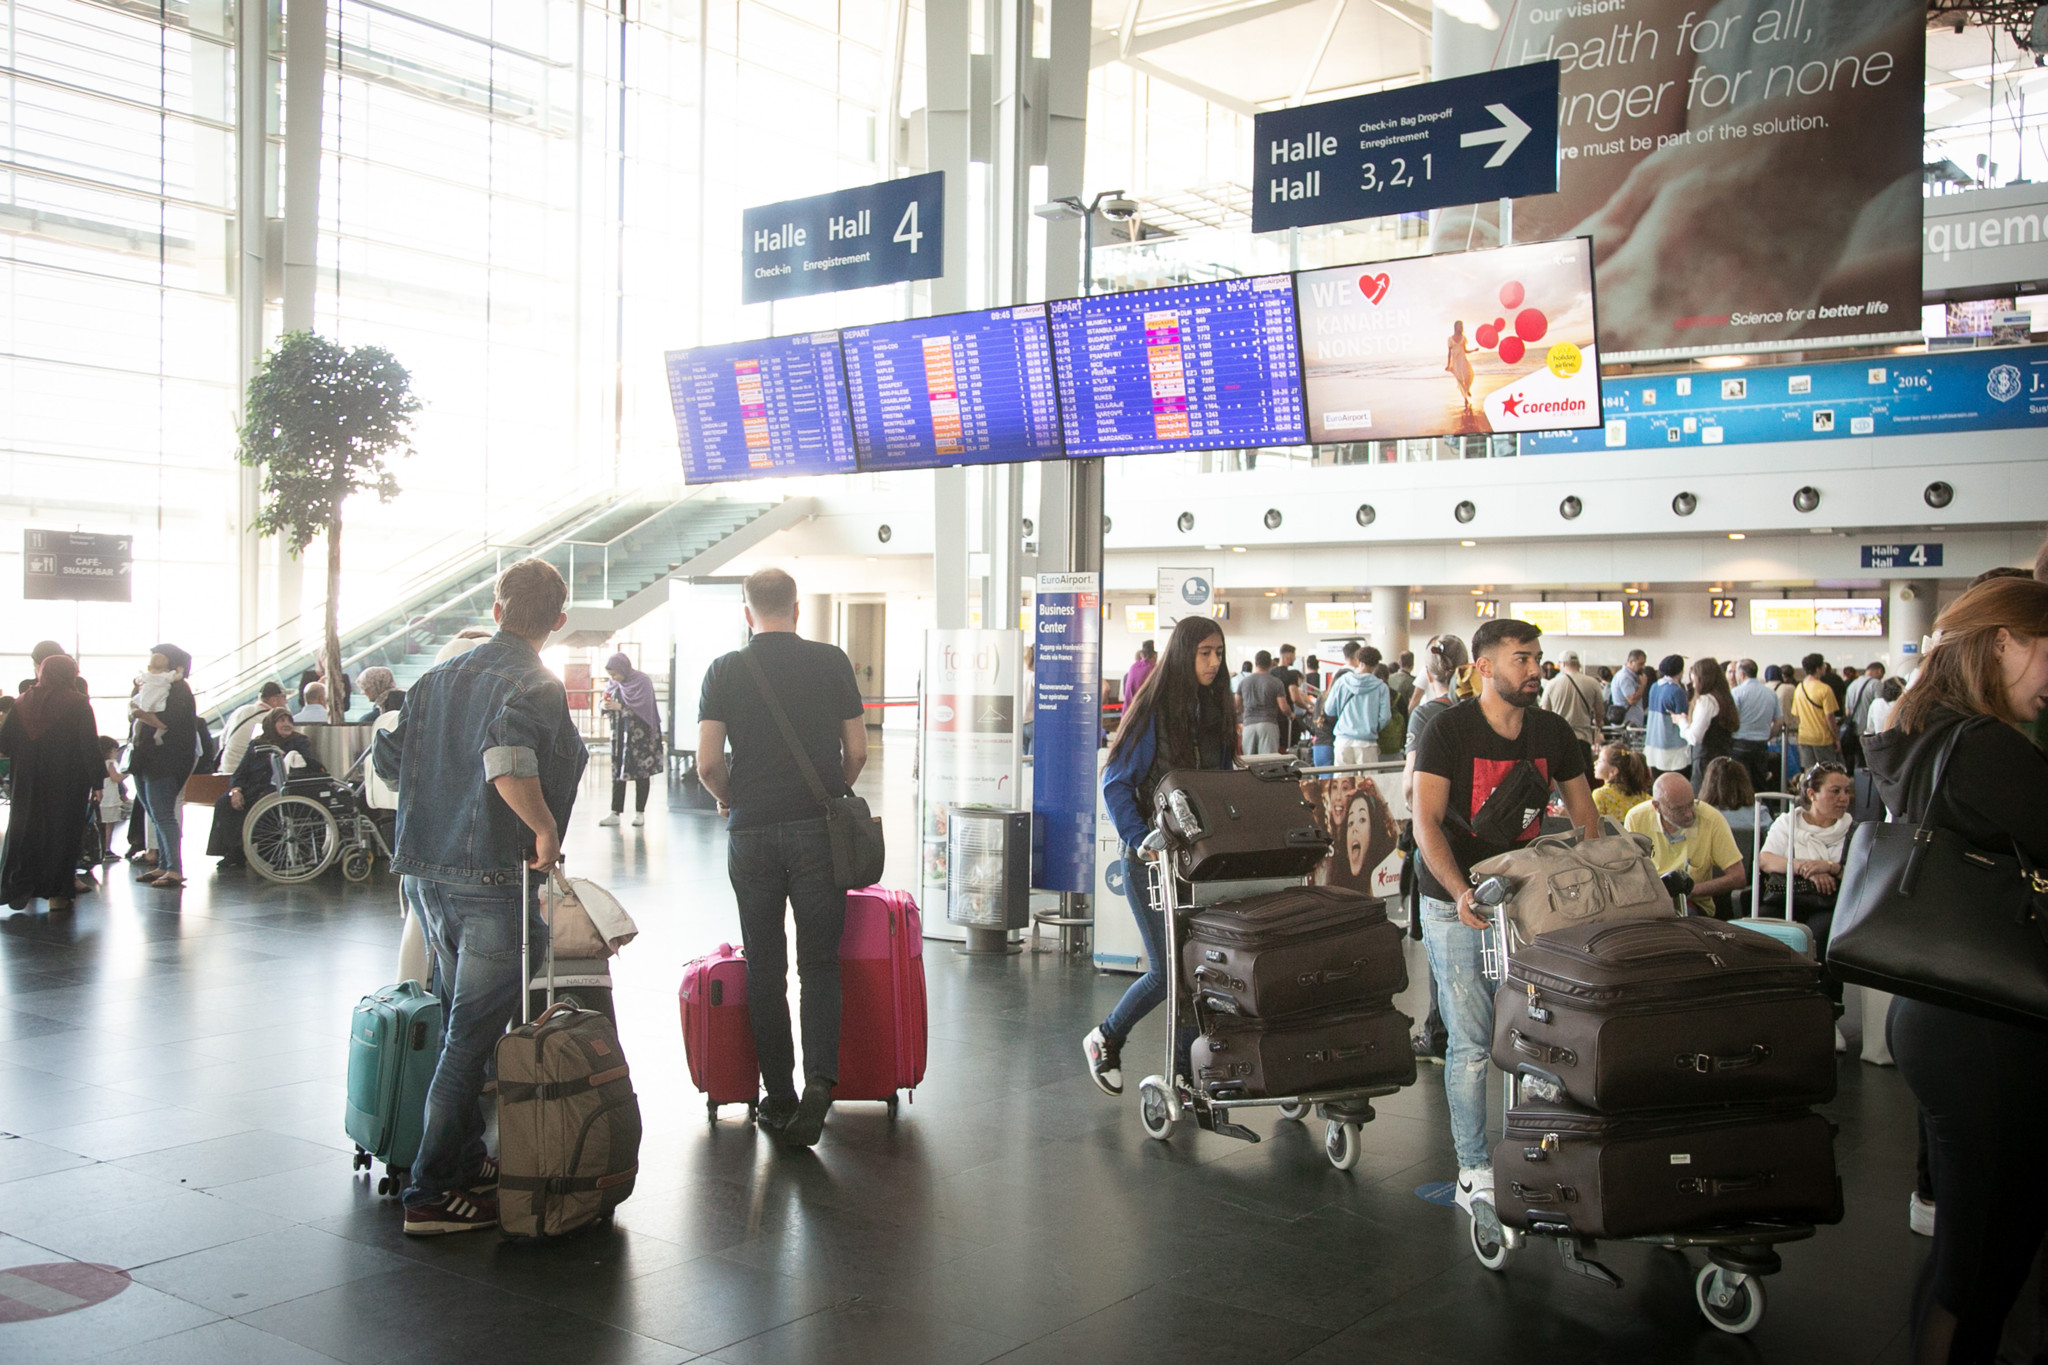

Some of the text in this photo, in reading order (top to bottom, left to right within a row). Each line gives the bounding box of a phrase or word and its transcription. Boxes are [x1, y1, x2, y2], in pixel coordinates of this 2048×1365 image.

[1530, 0, 1626, 24] Our vision:
[1520, 0, 1813, 74] Health for all,
[1687, 65, 1752, 110] for
[1764, 51, 1893, 100] none
[1359, 108, 1453, 133] Check-in Bag Drop-off
[1360, 130, 1430, 150] Enregistrement
[1561, 114, 1829, 161] re must be part of the solution.
[1271, 131, 1338, 165] Halle
[1271, 170, 1320, 203] Hall
[754, 201, 923, 254] Halle Hall 4
[1923, 213, 2048, 262] quem
[754, 251, 871, 279] Check-in Enregistrement
[1226, 281, 1250, 292] 09:45
[1311, 280, 1352, 308] WE
[990, 310, 1010, 321] 09:45
[1316, 308, 1411, 336] KANAREN
[1730, 301, 1889, 327] Science for a better life
[1086, 324, 1127, 334] ISTANBUL-SAW
[1087, 334, 1116, 342] BUDAPEST
[1317, 331, 1414, 359] NONSTOP
[1899, 376, 1927, 388] 2016
[1523, 397, 1586, 414] corendon
[2029, 404, 2048, 414] Sus
[1872, 545, 1928, 566] Halle 4
[1872, 557, 1893, 568] Hall
[63, 566, 114, 576] SNACK-BAR
[1039, 604, 1075, 616] Business
[1271, 602, 1289, 618] 76
[1476, 601, 1495, 617] 74
[1629, 600, 1650, 617] 73
[1713, 600, 1734, 617] 72
[1039, 621, 1067, 633] Center
[1039, 683, 1074, 691] Reiseveranstalter
[1039, 693, 1048, 701] Tour
[1039, 703, 1058, 711] Universal
